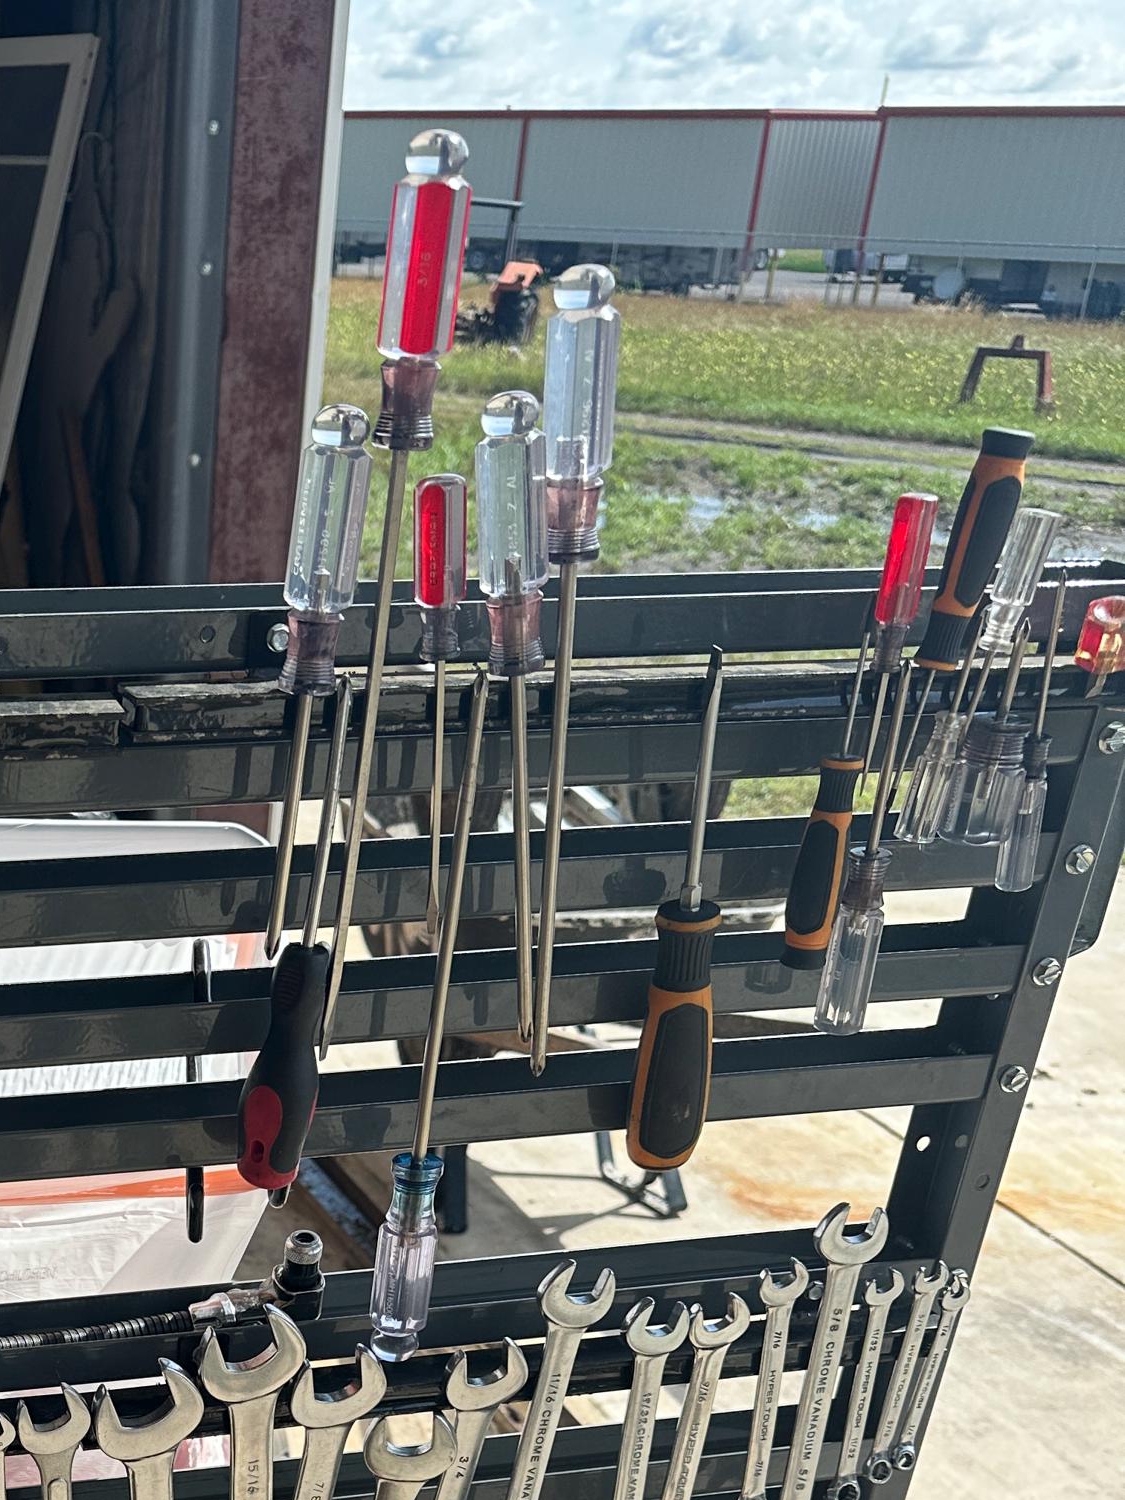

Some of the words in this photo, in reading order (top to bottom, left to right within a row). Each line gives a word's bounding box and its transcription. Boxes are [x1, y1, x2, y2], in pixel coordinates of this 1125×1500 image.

[292, 477, 312, 576] CRAFTSMAN
[829, 1308, 843, 1333] 5/8
[772, 1330, 783, 1349] 7/16
[868, 1328, 881, 1352] 11/32
[815, 1341, 835, 1395] CHROME
[861, 1360, 873, 1394] HYPER
[902, 1344, 916, 1377] HYPER
[545, 1372, 562, 1404] 11/16
[698, 1380, 711, 1404] 9/16
[765, 1369, 776, 1406] HYPER
[892, 1379, 906, 1409] TOUGH
[760, 1408, 771, 1441] TOUGH
[854, 1396, 866, 1429] TOUGH
[530, 1409, 552, 1462] CHROME
[683, 1421, 701, 1464] HYPER
[801, 1398, 824, 1461] VANADIUM
[630, 1428, 646, 1476] CHROME
[847, 1437, 859, 1459] 11/32
[247, 1459, 260, 1495] 15/16
[455, 1456, 469, 1479] 3/4
[795, 1468, 808, 1491] 5/8
